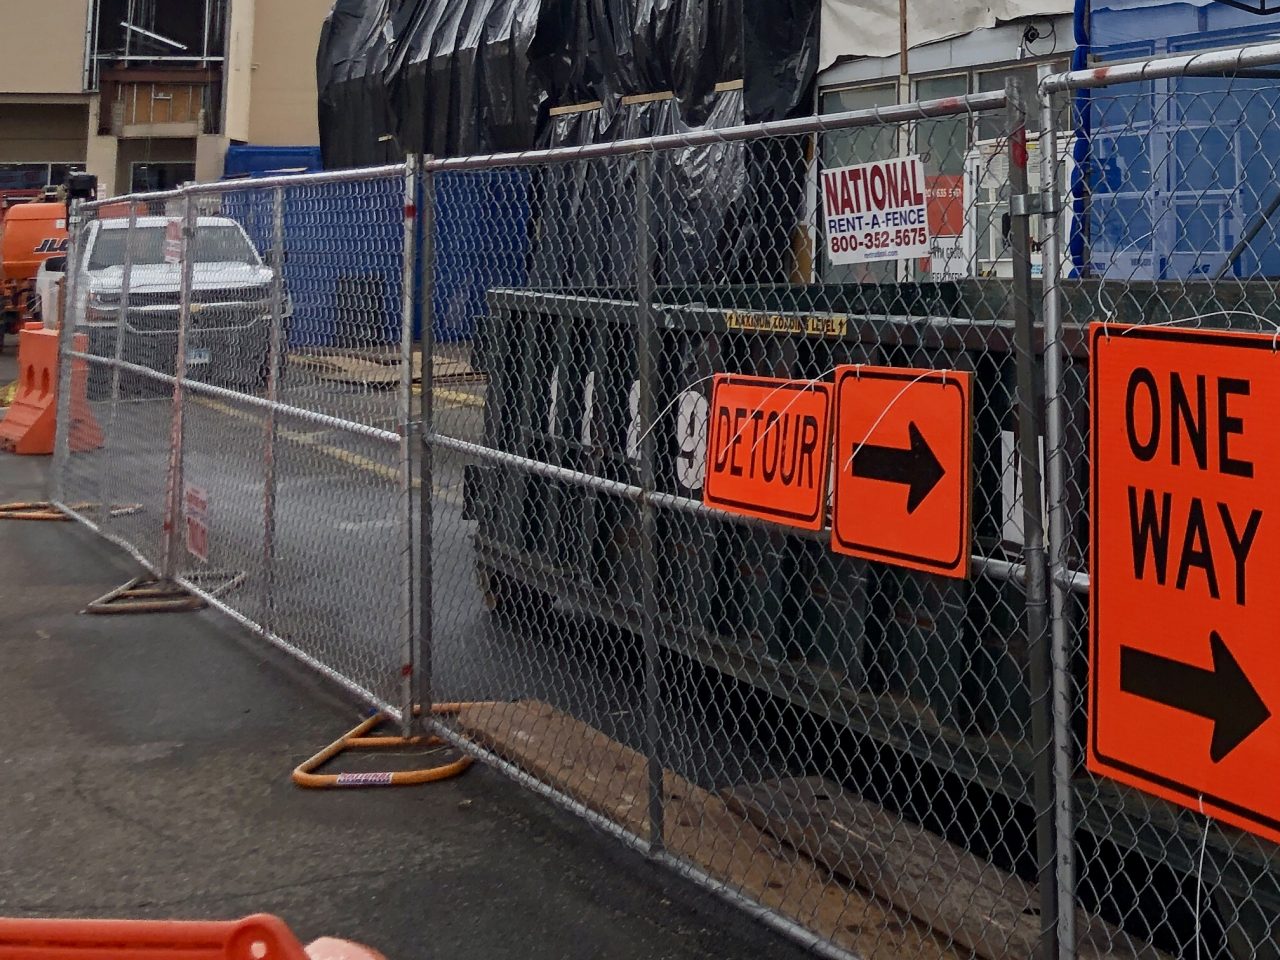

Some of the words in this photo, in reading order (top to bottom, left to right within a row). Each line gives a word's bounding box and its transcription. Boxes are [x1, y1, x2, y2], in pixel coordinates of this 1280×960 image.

[825, 160, 924, 216] NATIONAL
[829, 208, 926, 234] RENT-A-FENCE
[831, 227, 927, 253] 800-352-5675
[811, 318, 836, 333] LEVEL
[714, 406, 819, 489] DETOUR
[1126, 367, 1255, 478] ONE
[1128, 485, 1263, 606] WAY
